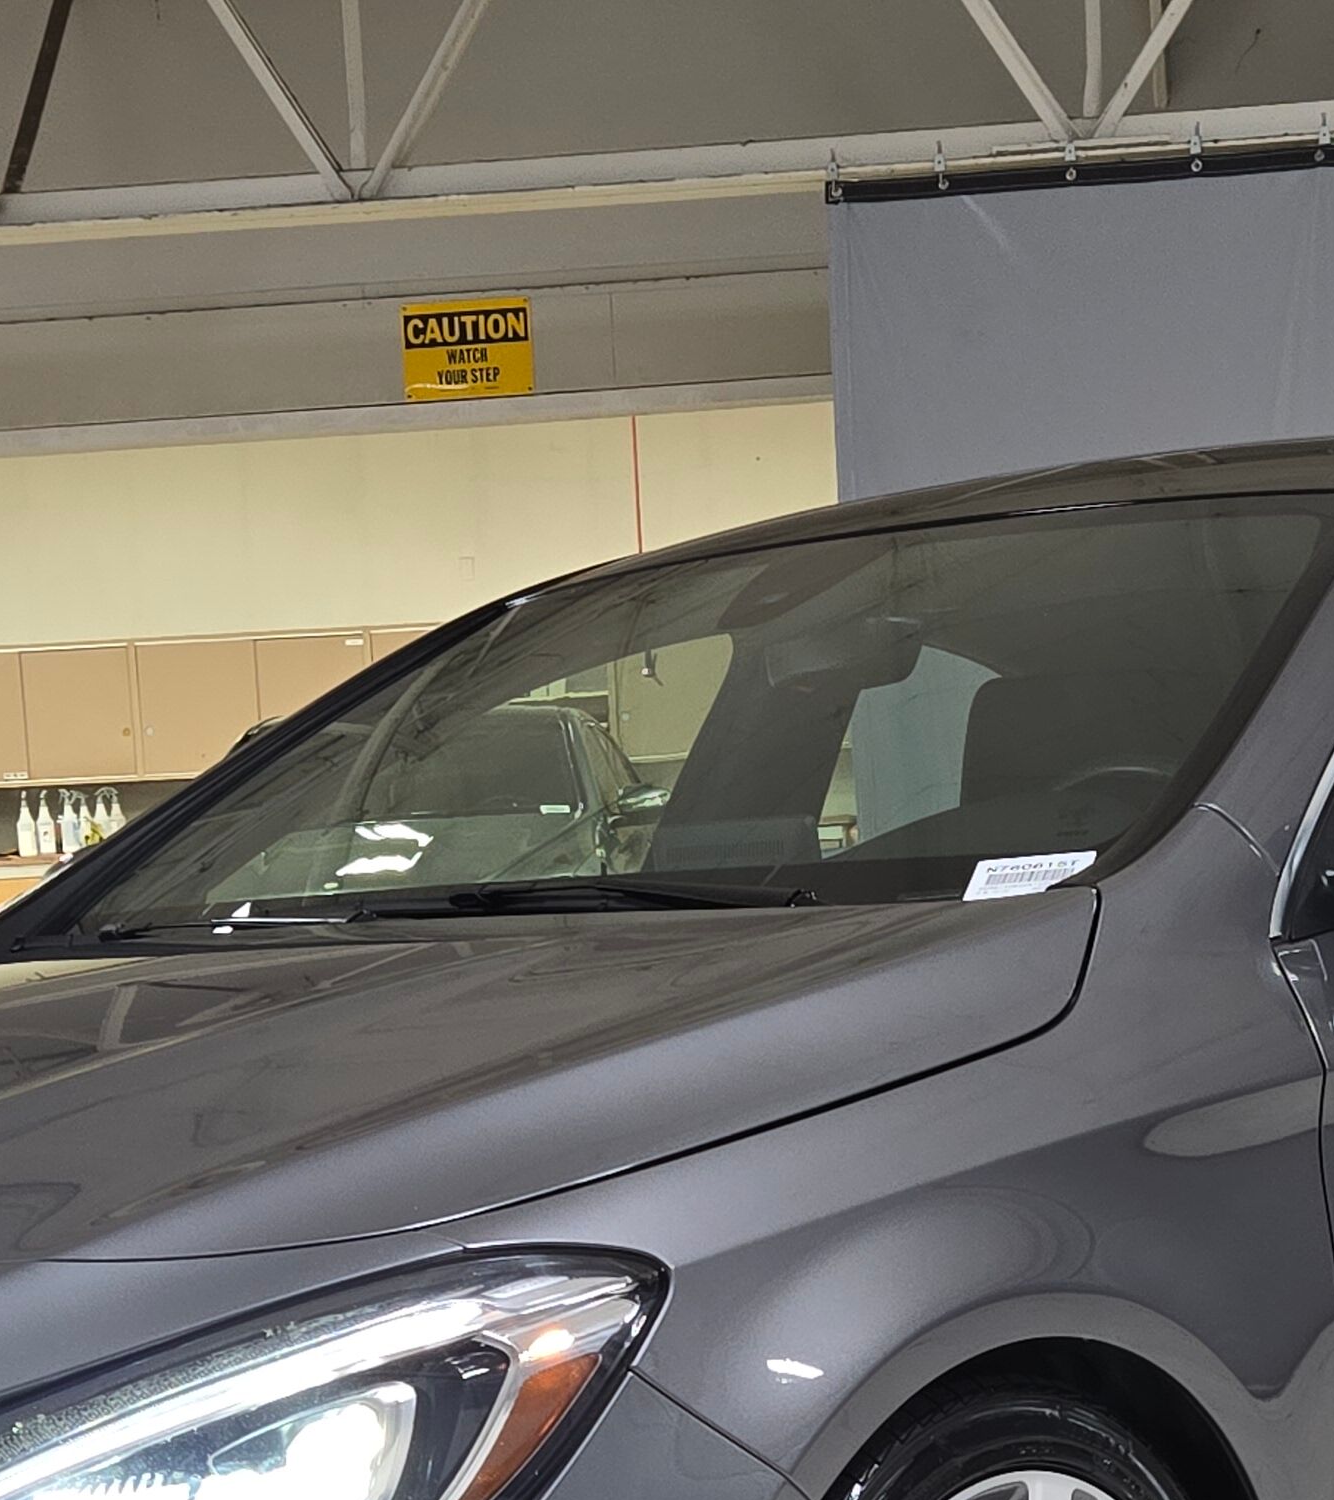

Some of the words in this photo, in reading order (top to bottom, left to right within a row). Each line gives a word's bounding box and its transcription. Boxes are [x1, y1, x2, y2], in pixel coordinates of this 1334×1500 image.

[406, 311, 526, 344] CAUTION
[446, 347, 489, 365] WATCH
[436, 369, 469, 385] YOUR
[470, 366, 501, 384] STEP
